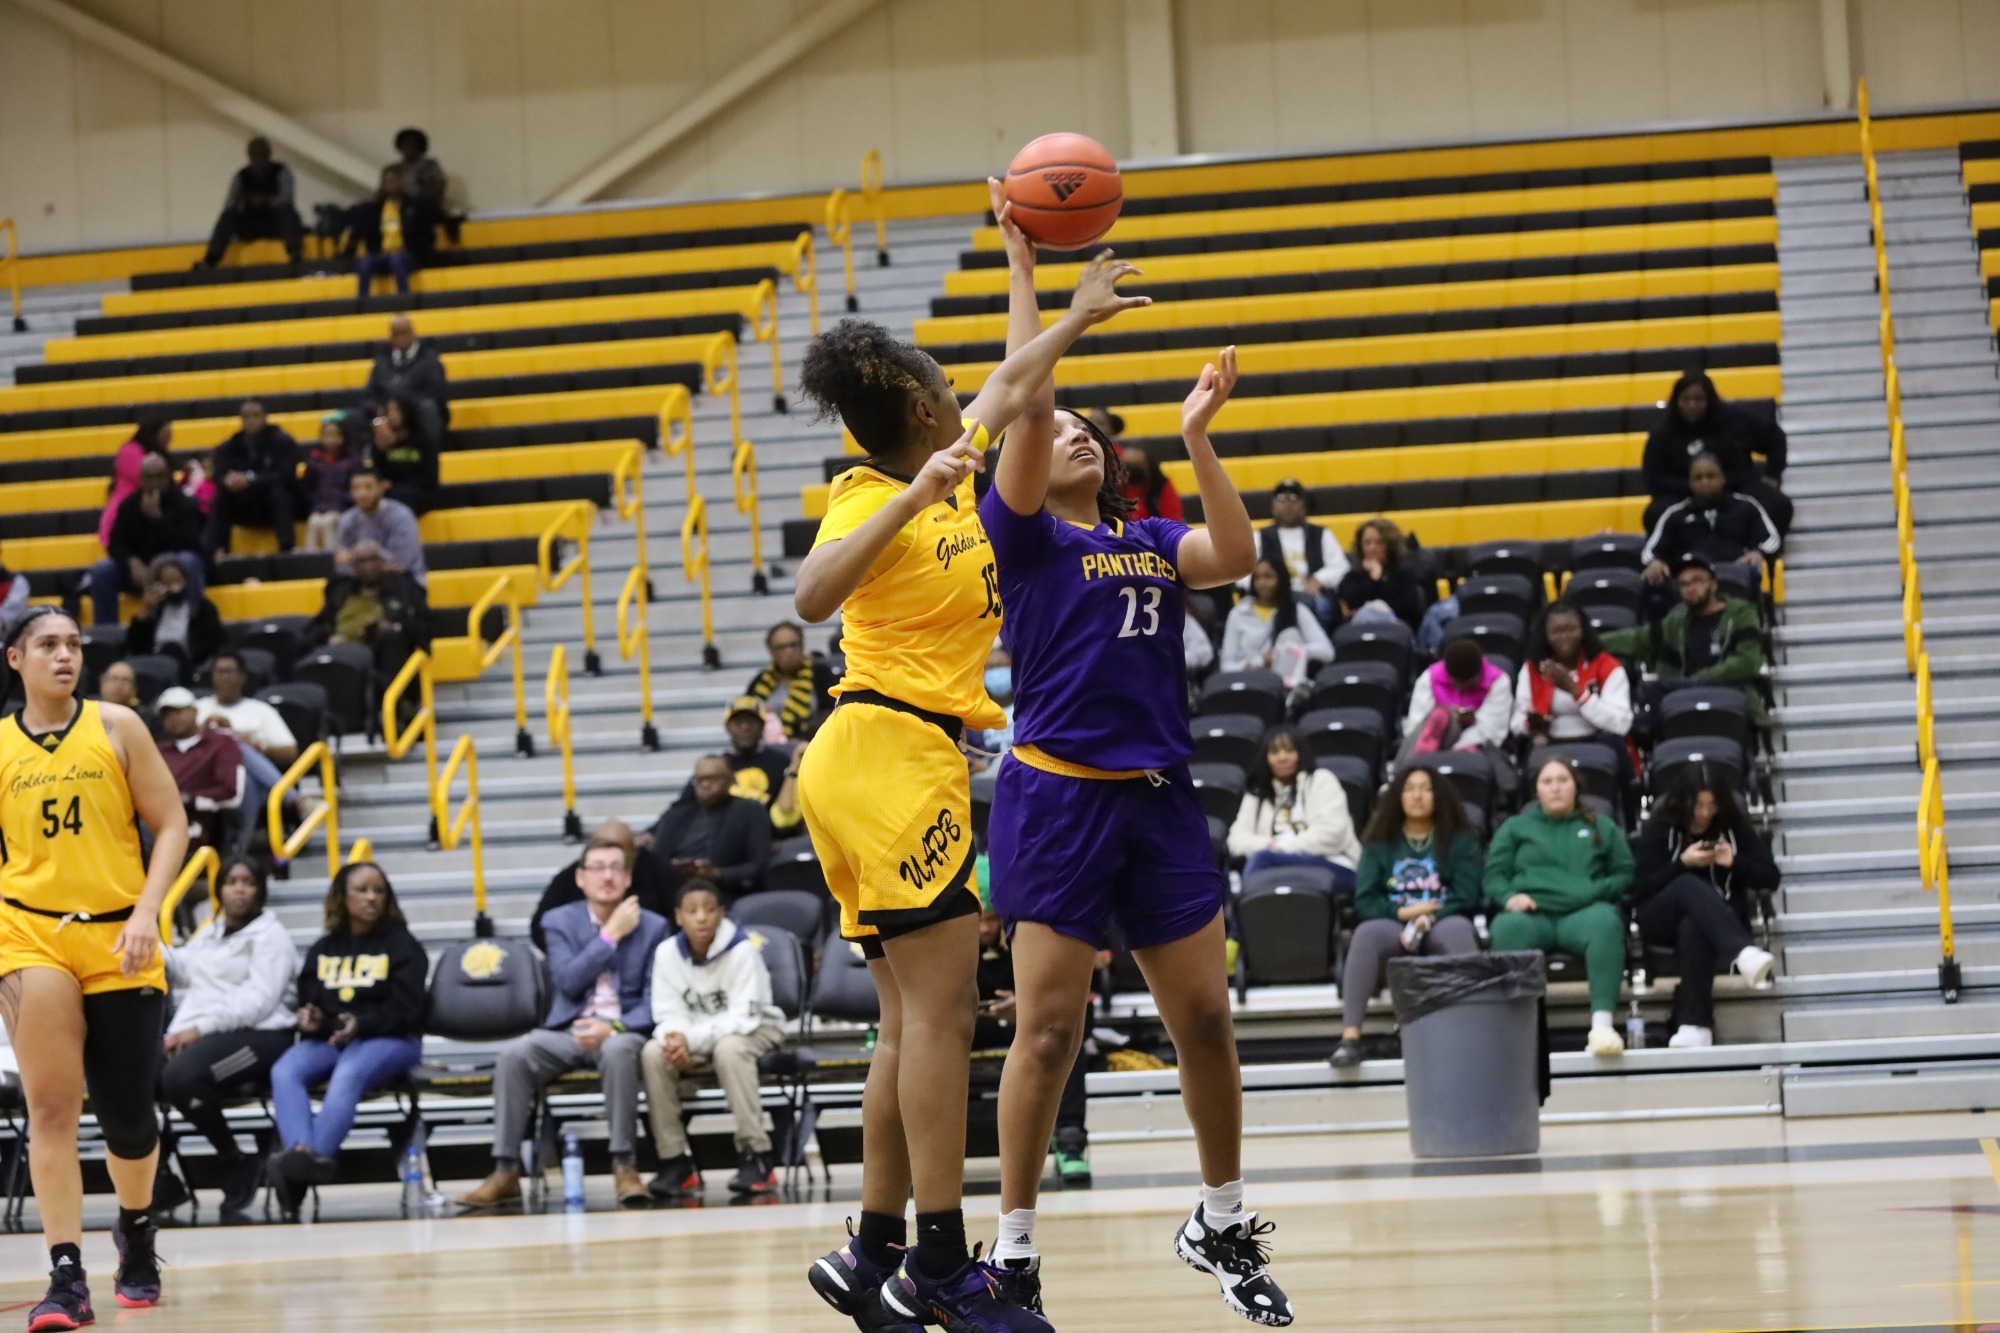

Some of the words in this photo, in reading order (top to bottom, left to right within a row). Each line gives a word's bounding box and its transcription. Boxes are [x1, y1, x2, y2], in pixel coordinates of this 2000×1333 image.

[1042, 172, 1087, 183] adidas
[936, 531, 977, 570] Golden
[1081, 551, 1177, 582] PANTHERS
[978, 562, 1003, 619] 15
[1117, 586, 1162, 638] 23
[11, 772, 56, 799] Golden
[62, 764, 104, 781] Lions
[42, 795, 82, 839] 54
[899, 808, 961, 890] UAPB
